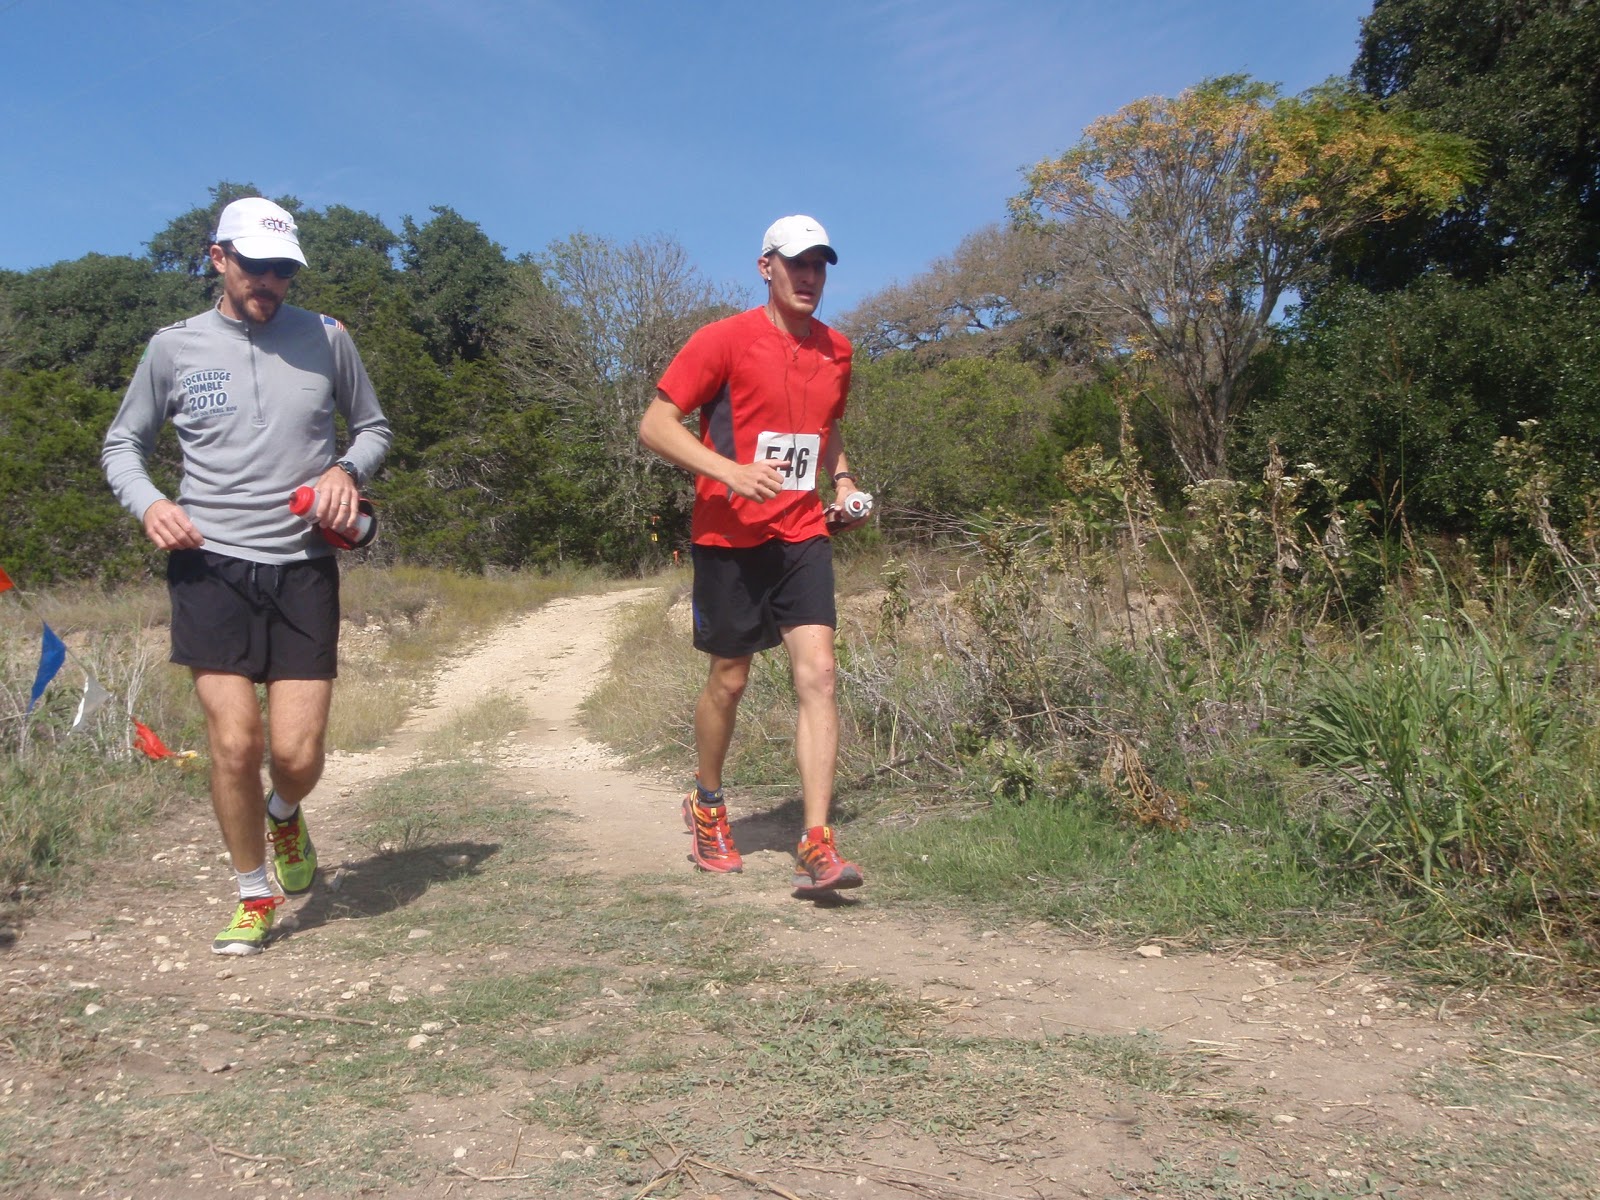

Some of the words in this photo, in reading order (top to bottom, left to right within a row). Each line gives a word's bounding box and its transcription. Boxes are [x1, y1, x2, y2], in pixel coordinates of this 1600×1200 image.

[263, 218, 288, 232] GU
[188, 381, 223, 395] RUMBLE
[189, 392, 227, 411] 2010
